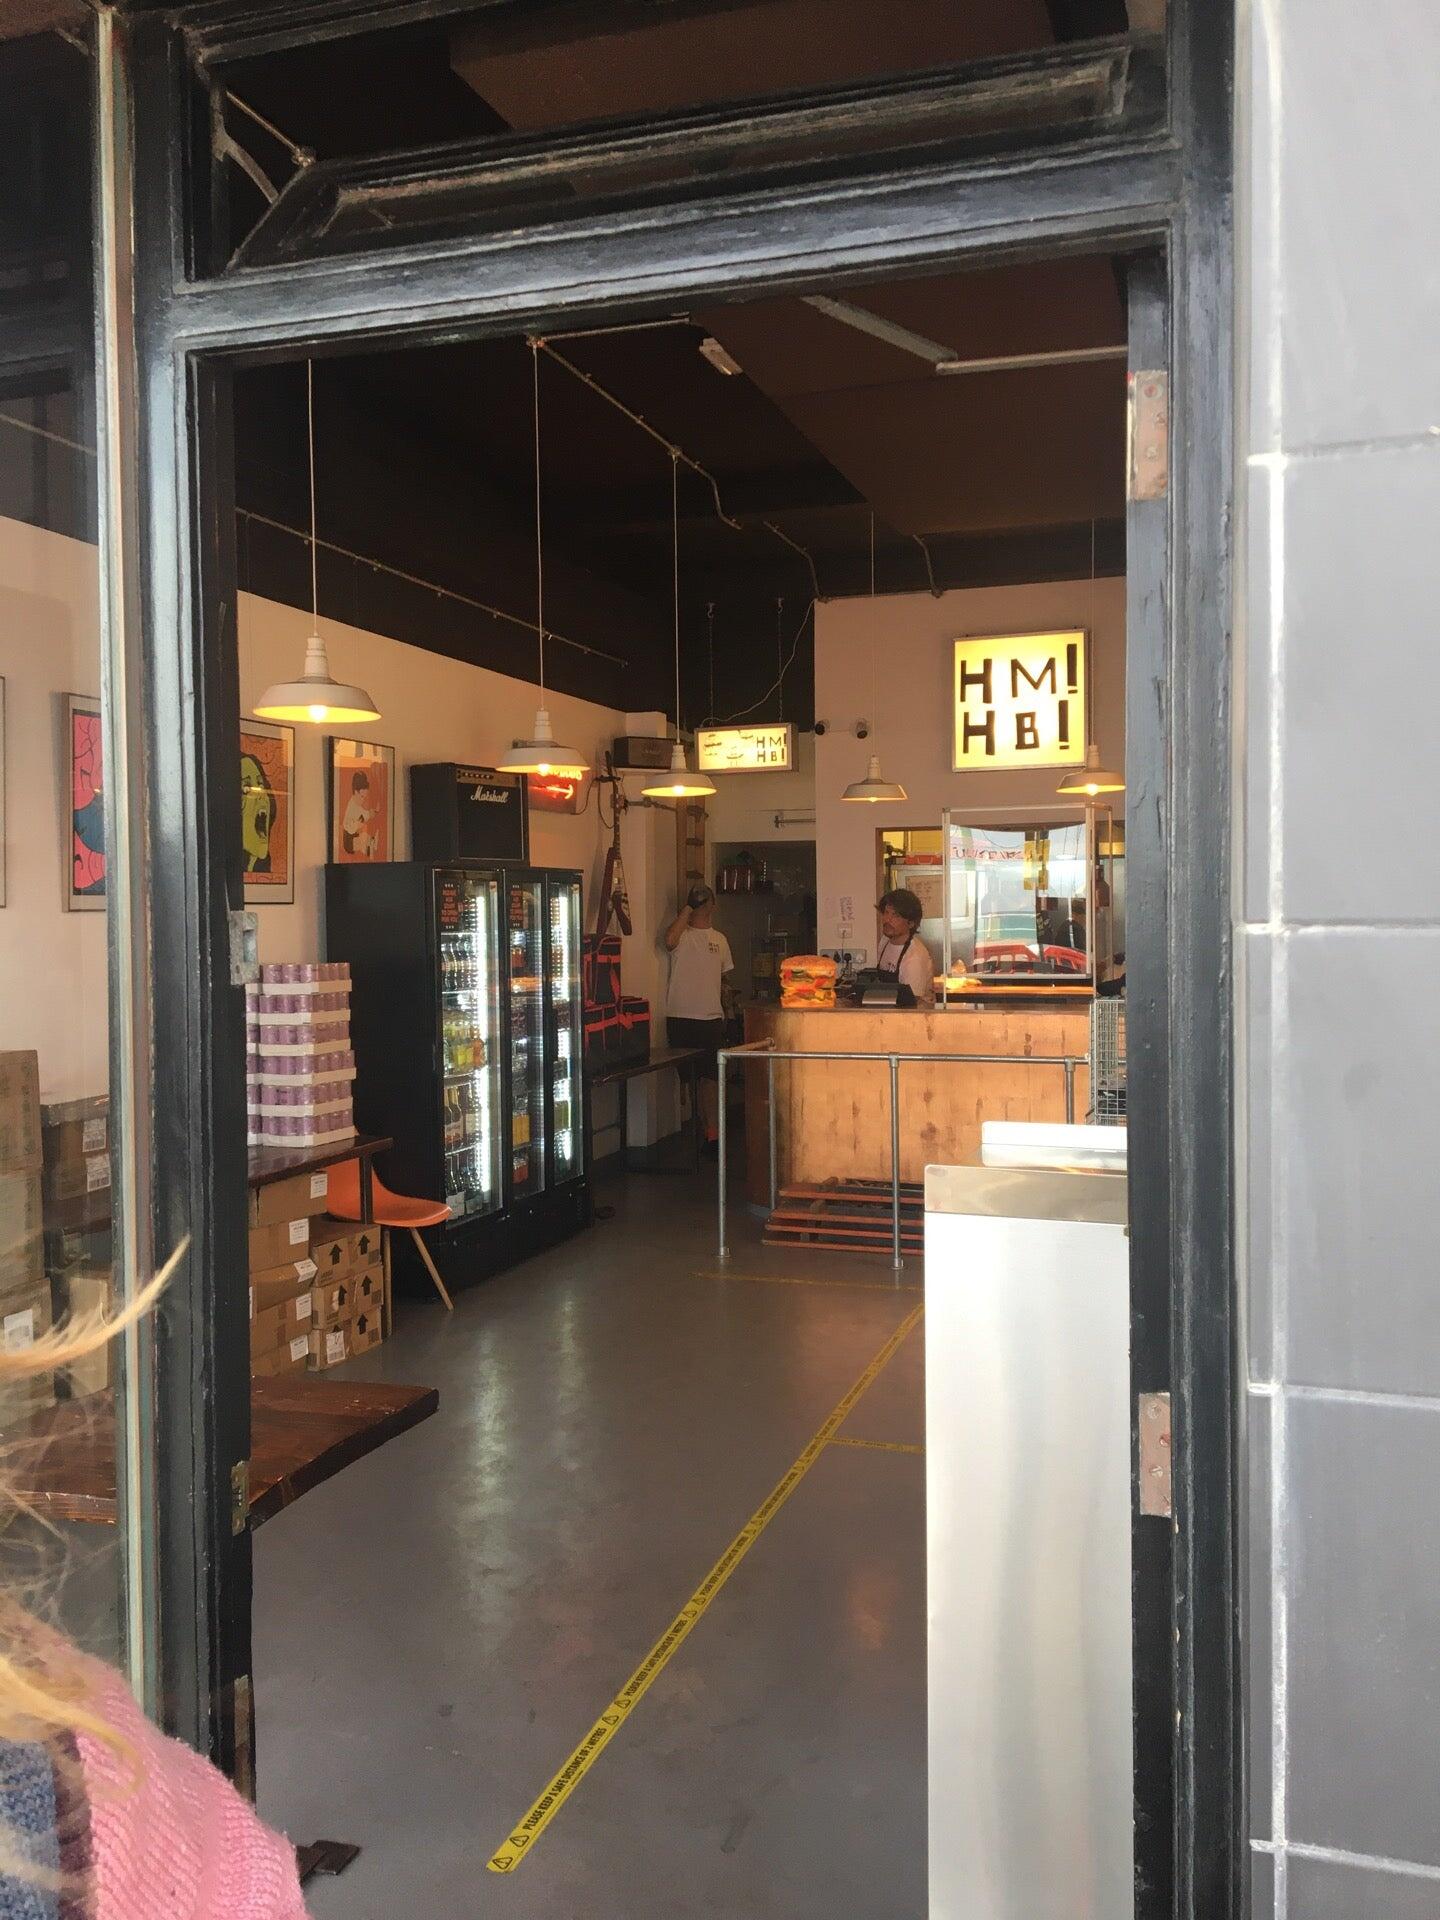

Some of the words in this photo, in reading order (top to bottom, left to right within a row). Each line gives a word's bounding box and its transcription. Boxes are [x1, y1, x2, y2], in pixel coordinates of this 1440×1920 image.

[470, 785, 509, 803] Marshall
[522, 1809, 545, 1830] PLEASE
[538, 1796, 554, 1811] KEEP
[552, 1778, 569, 1792] SAFE
[561, 1756, 586, 1780] DISTANCE
[589, 1727, 607, 1746] METRES
